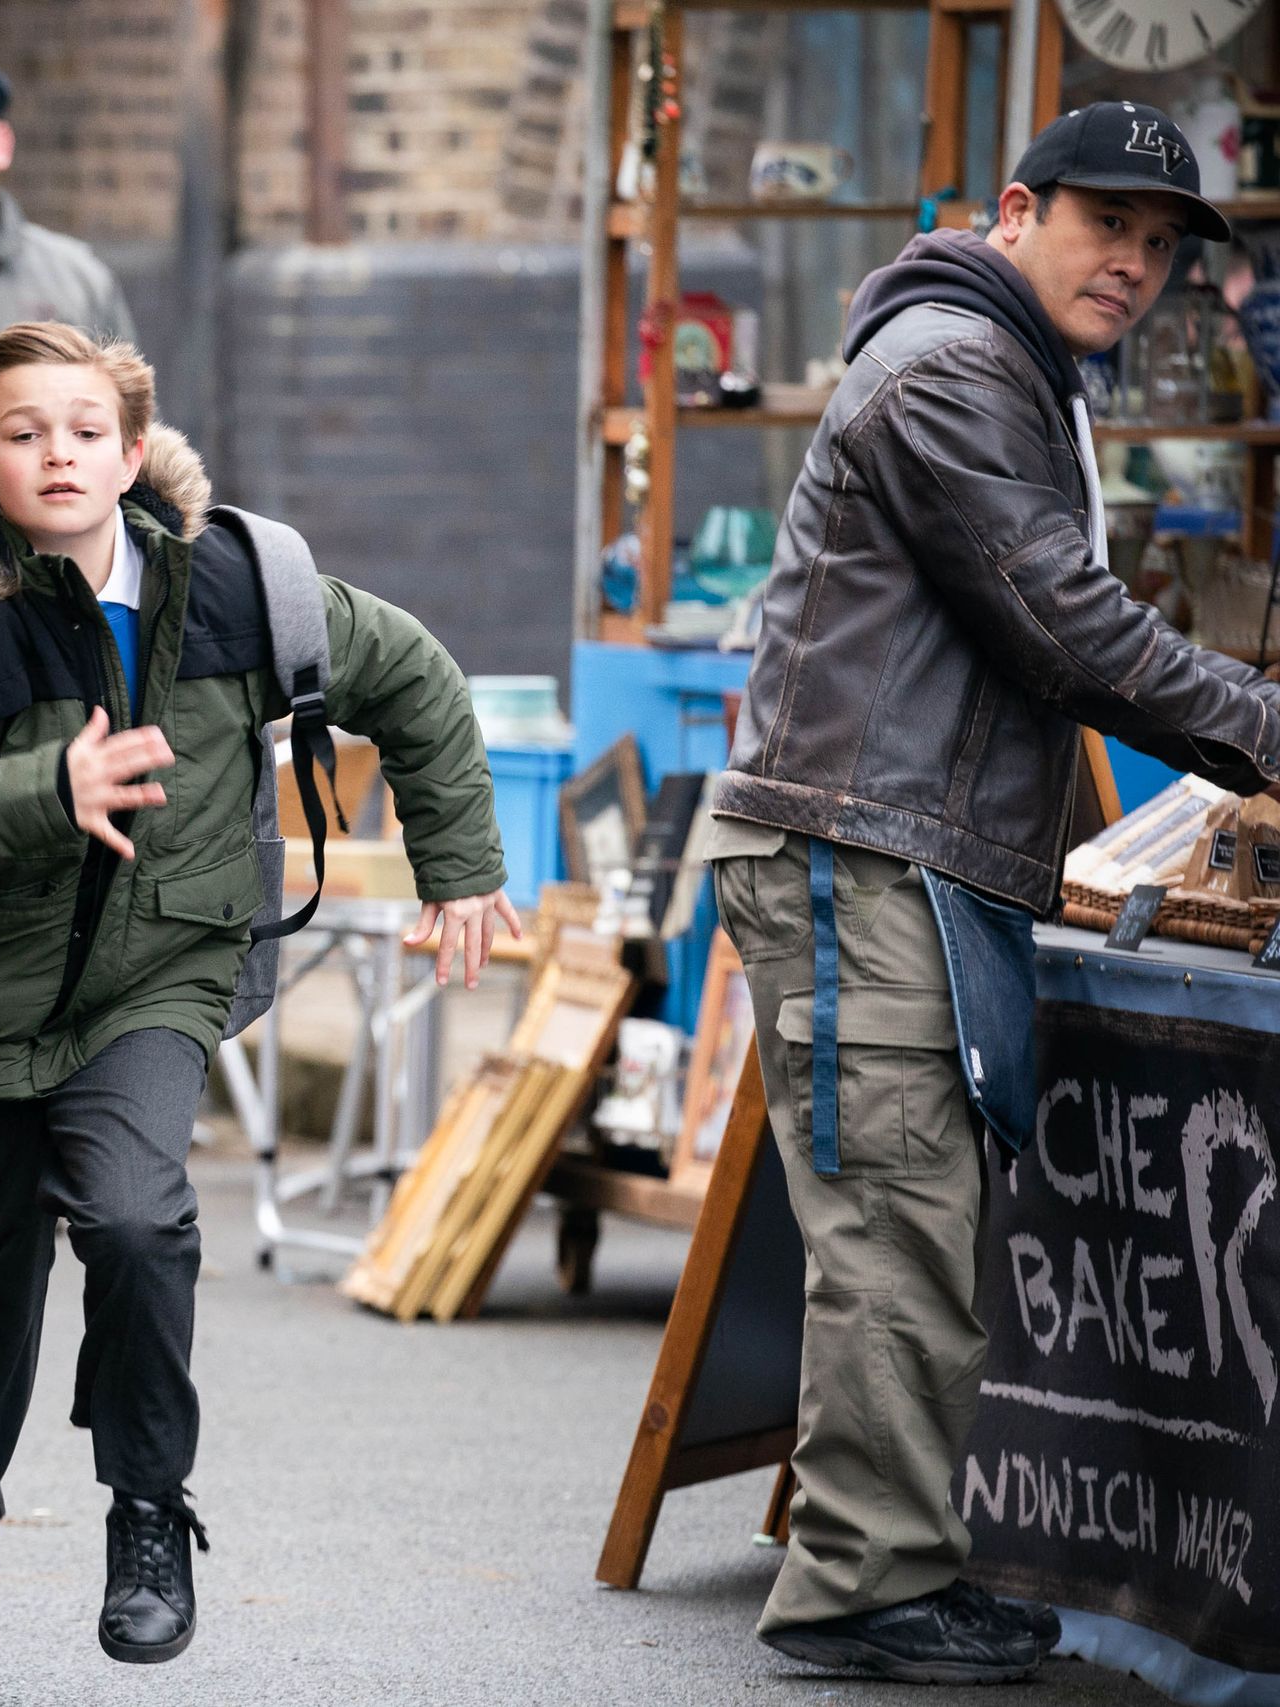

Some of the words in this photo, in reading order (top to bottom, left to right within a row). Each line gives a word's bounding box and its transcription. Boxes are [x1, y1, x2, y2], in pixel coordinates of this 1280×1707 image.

[1125, 120, 1189, 176] LV
[948, 1449, 1158, 1556] NDWICH
[1173, 1489, 1253, 1606] MAKER
